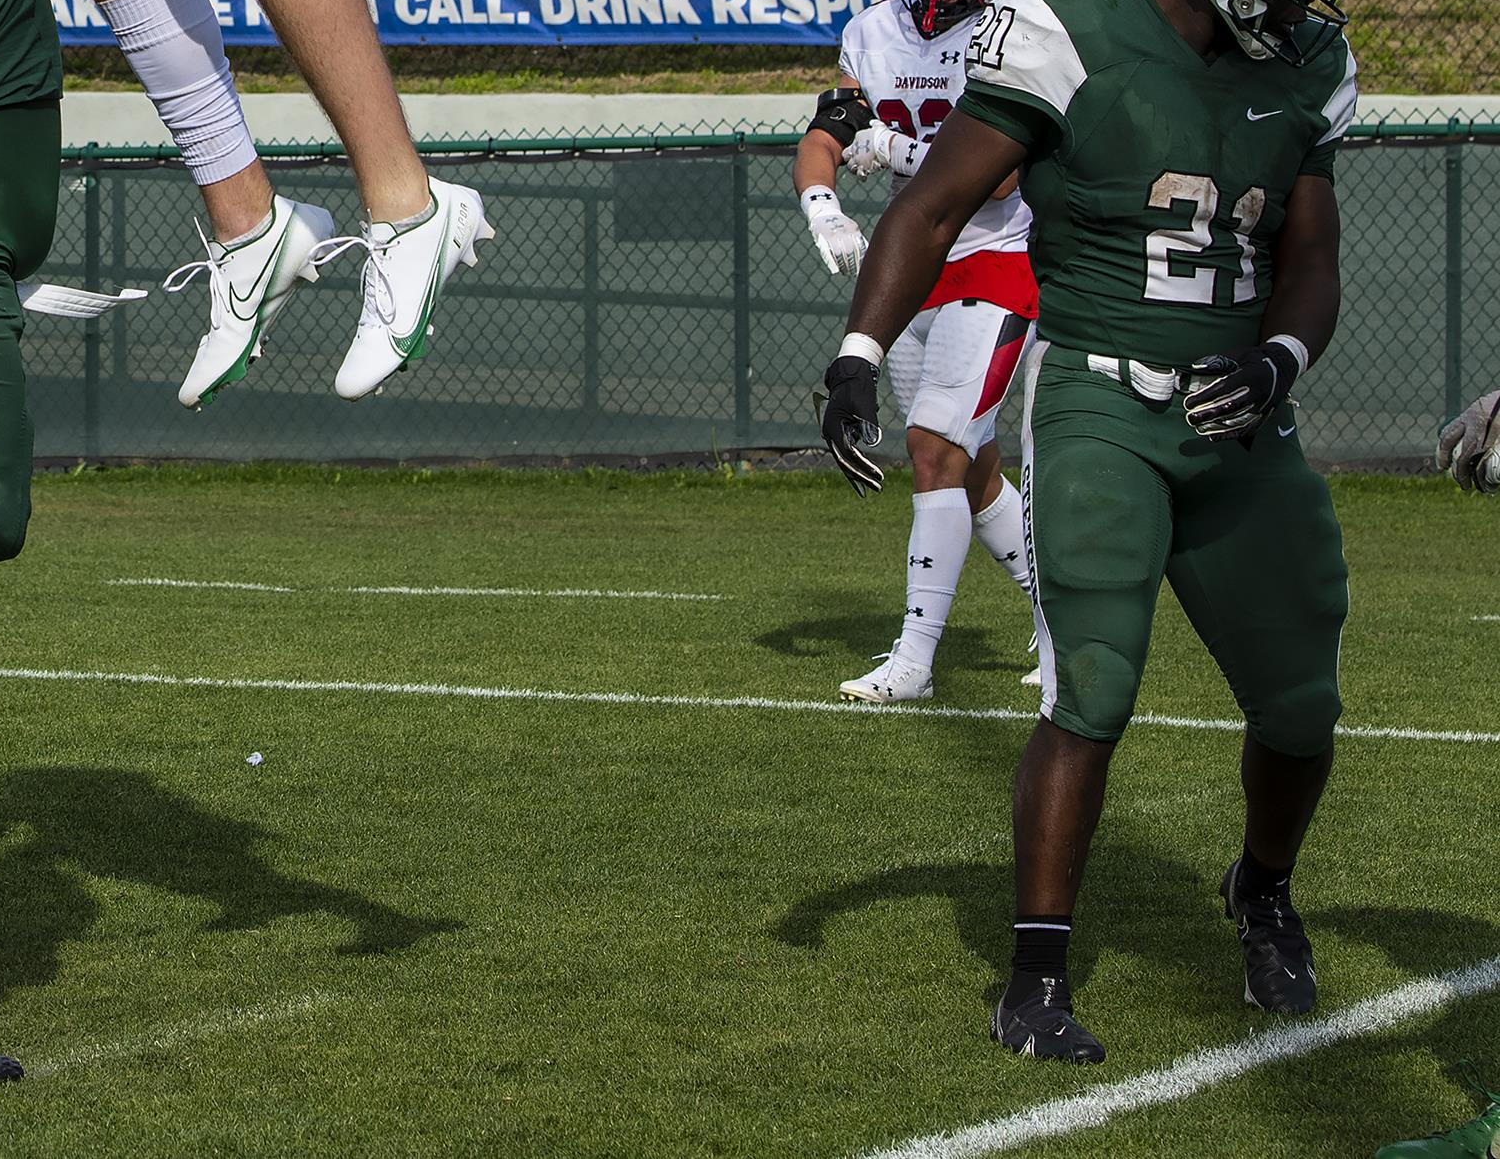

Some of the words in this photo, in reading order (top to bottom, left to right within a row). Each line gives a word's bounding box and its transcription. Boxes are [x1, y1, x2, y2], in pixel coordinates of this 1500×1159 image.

[965, 3, 1016, 71] 21
[894, 76, 950, 90] DAVIDSON
[1143, 169, 1266, 307] 21
